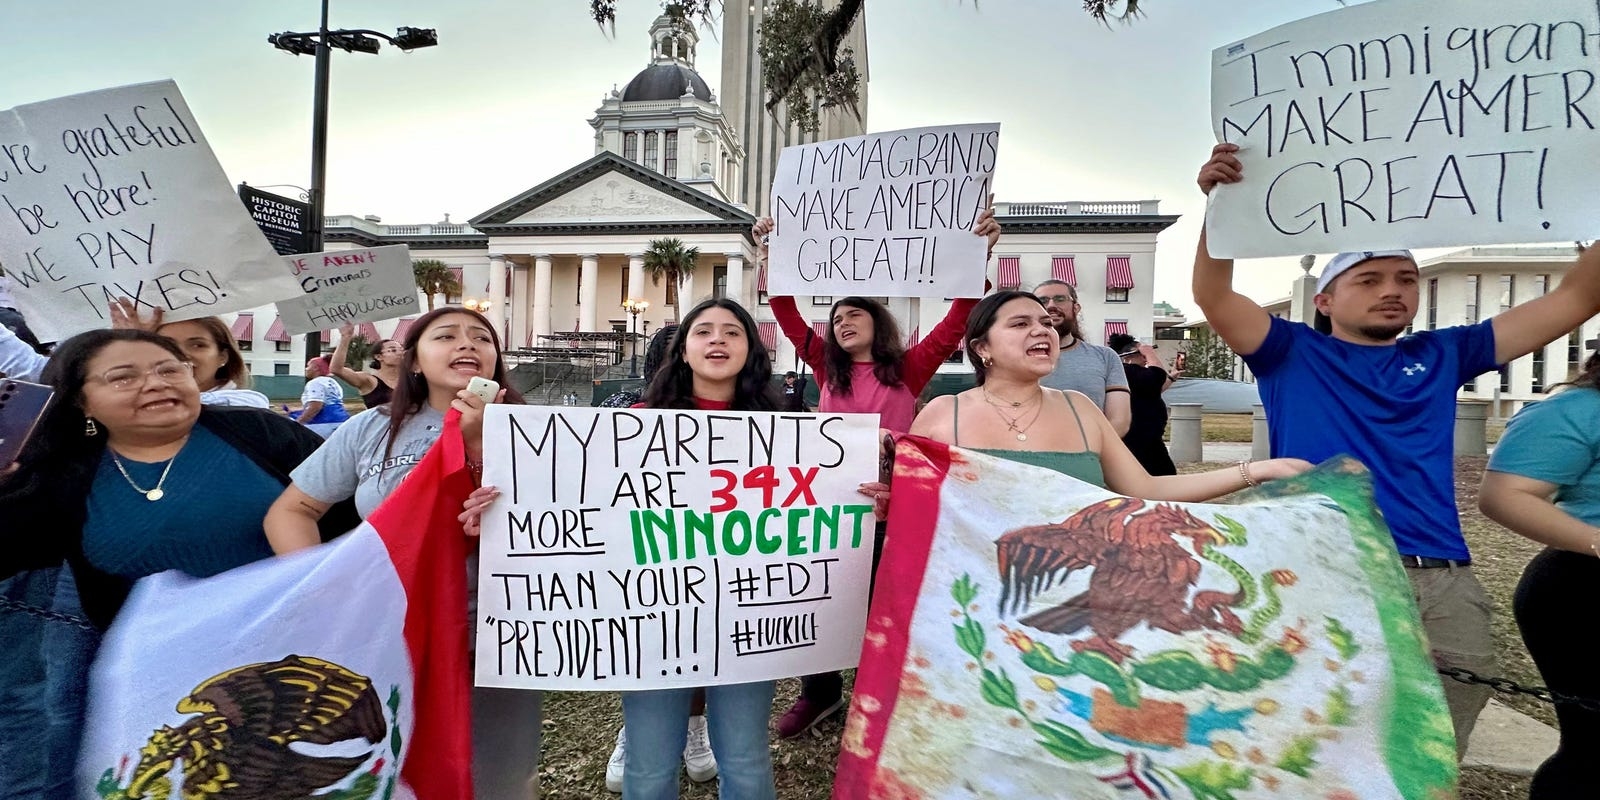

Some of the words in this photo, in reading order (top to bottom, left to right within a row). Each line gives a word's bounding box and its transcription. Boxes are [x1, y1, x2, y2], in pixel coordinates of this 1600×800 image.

[1222, 87, 1392, 158] MAKE
[1405, 69, 1595, 143] AMER
[0, 143, 47, 182] re
[62, 97, 197, 190] grateful
[797, 130, 999, 185] IMMAGRANTS
[2, 194, 59, 235] be
[64, 171, 158, 223] here!
[251, 195, 302, 215] HISTORIC
[254, 205, 299, 222] CAPITOL
[777, 186, 860, 237] MAKE
[864, 175, 989, 232] AMERICA
[1266, 147, 1551, 236] GREAT!
[252, 211, 300, 229] MUSEUM
[5, 247, 67, 288] WE
[76, 223, 155, 269] PAY
[797, 236, 937, 284] GREAT!!
[60, 269, 228, 320] TAXES!
[367, 453, 425, 478] WORL
[508, 412, 600, 505] MY
[612, 412, 845, 469] PARENTS
[610, 471, 689, 508] ARE
[709, 465, 820, 513] 34X
[507, 508, 606, 550] MORE
[629, 504, 874, 565] INNOCENT
[491, 570, 598, 612] THAN
[608, 566, 706, 610] YOUR
[728, 558, 839, 602] #FDT
